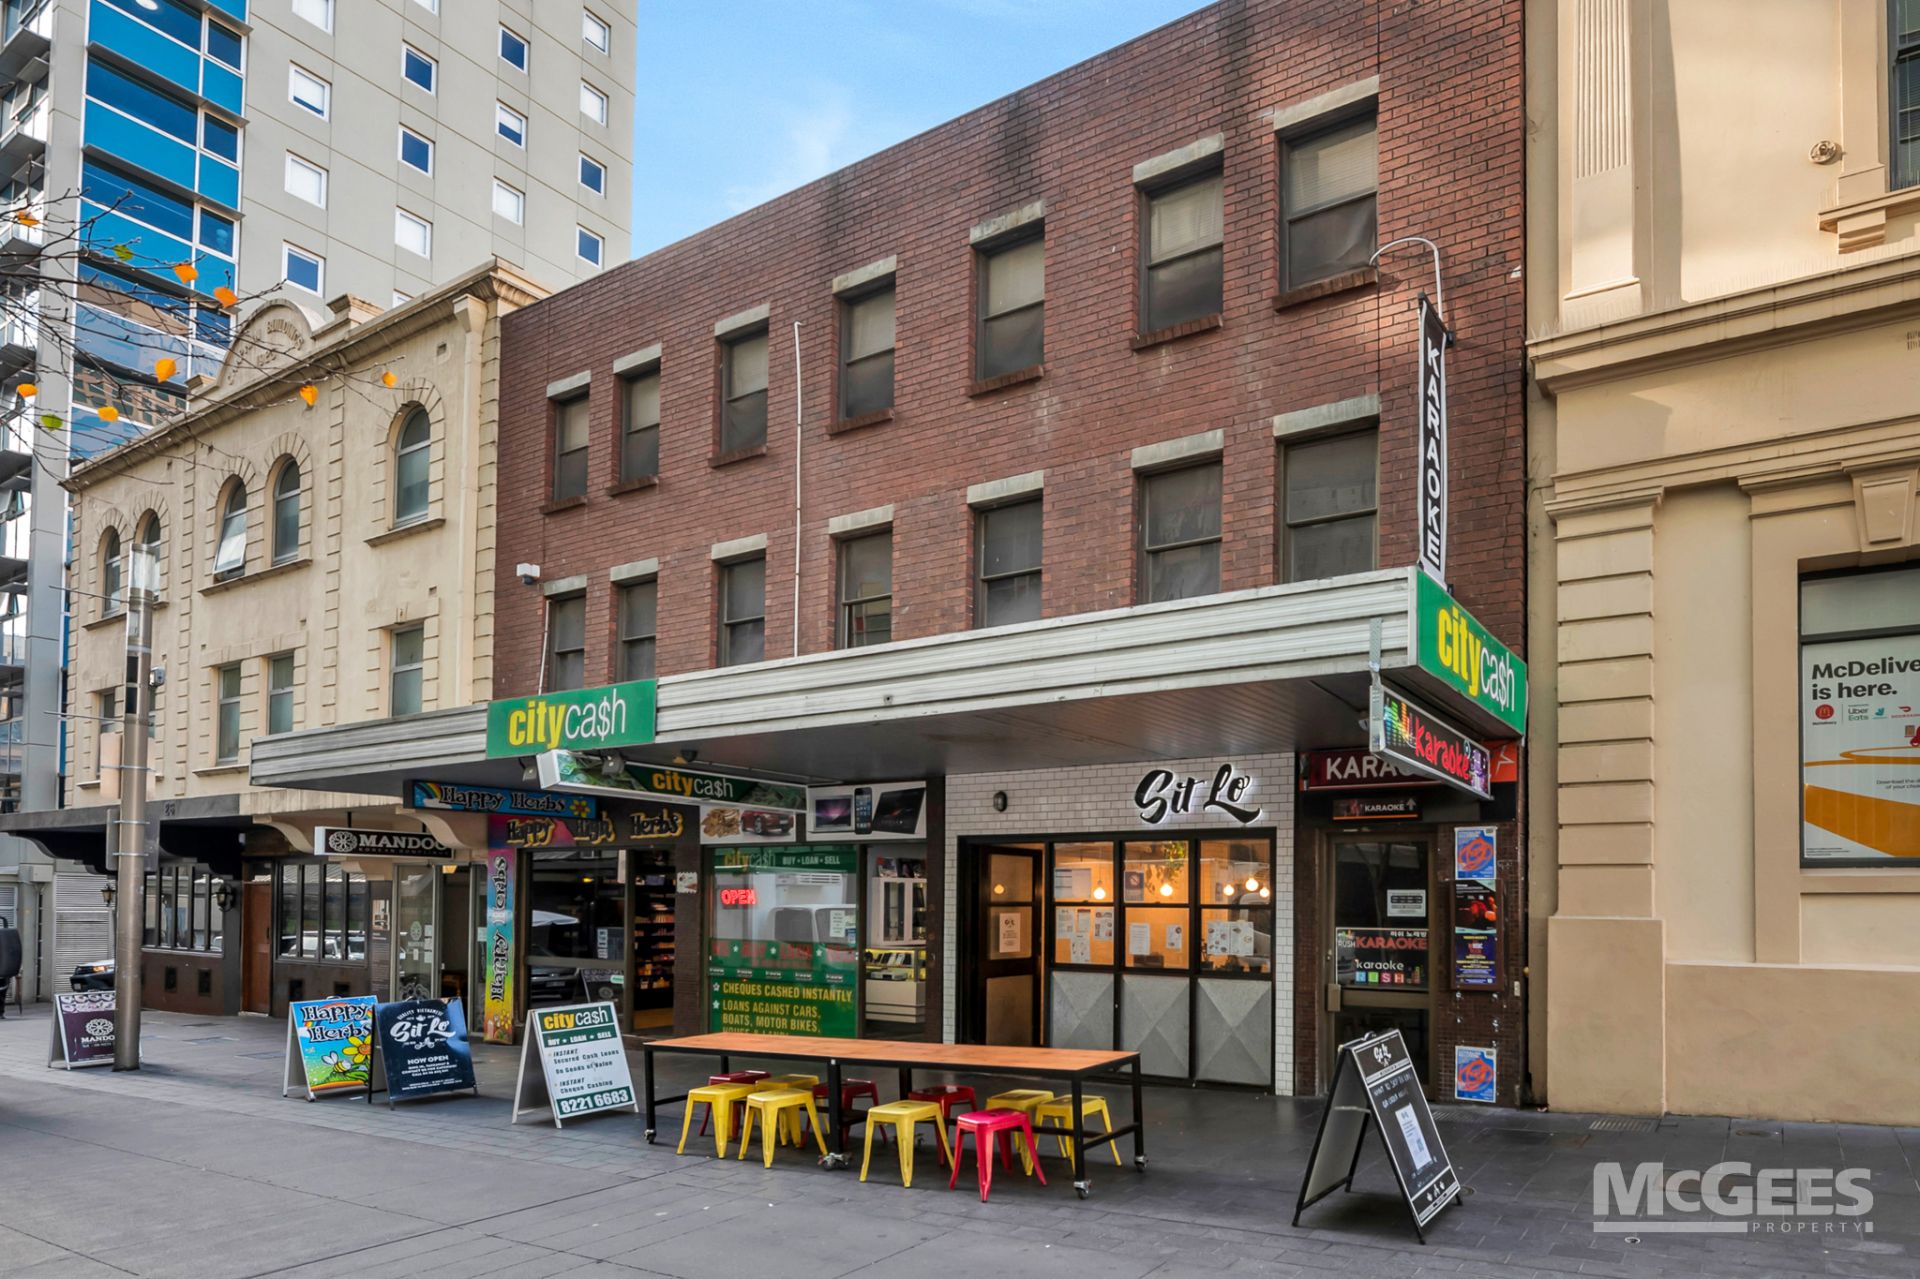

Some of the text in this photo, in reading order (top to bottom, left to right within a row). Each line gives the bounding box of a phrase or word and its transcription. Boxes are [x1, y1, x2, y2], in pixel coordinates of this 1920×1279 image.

[1427, 337, 1440, 566] KARAOKE
[1812, 683, 1898, 700] is here.
[438, 786, 566, 811] Happy Herbs
[1203, 763, 1261, 823] Lo
[1365, 804, 1405, 812] KARAOKE
[507, 818, 556, 848] Happy
[782, 856, 840, 865] BUY LOAN SELL
[721, 889, 757, 904] OPEN
[1356, 937, 1427, 950] KARAOKE
[1356, 961, 1404, 970] karaoke
[723, 982, 853, 1002] CHEQUES CASHED INSTANTLY
[302, 1005, 368, 1022] Happy
[723, 1000, 750, 1012] LOANS
[752, 1002, 790, 1015] AGAINST
[390, 1017, 456, 1042] Sit Lo
[756, 1015, 788, 1029] MOTOR
[308, 1022, 372, 1042] Herbs
[427, 1055, 449, 1063] OPEN
[560, 1090, 629, 1113] 8221 6683
